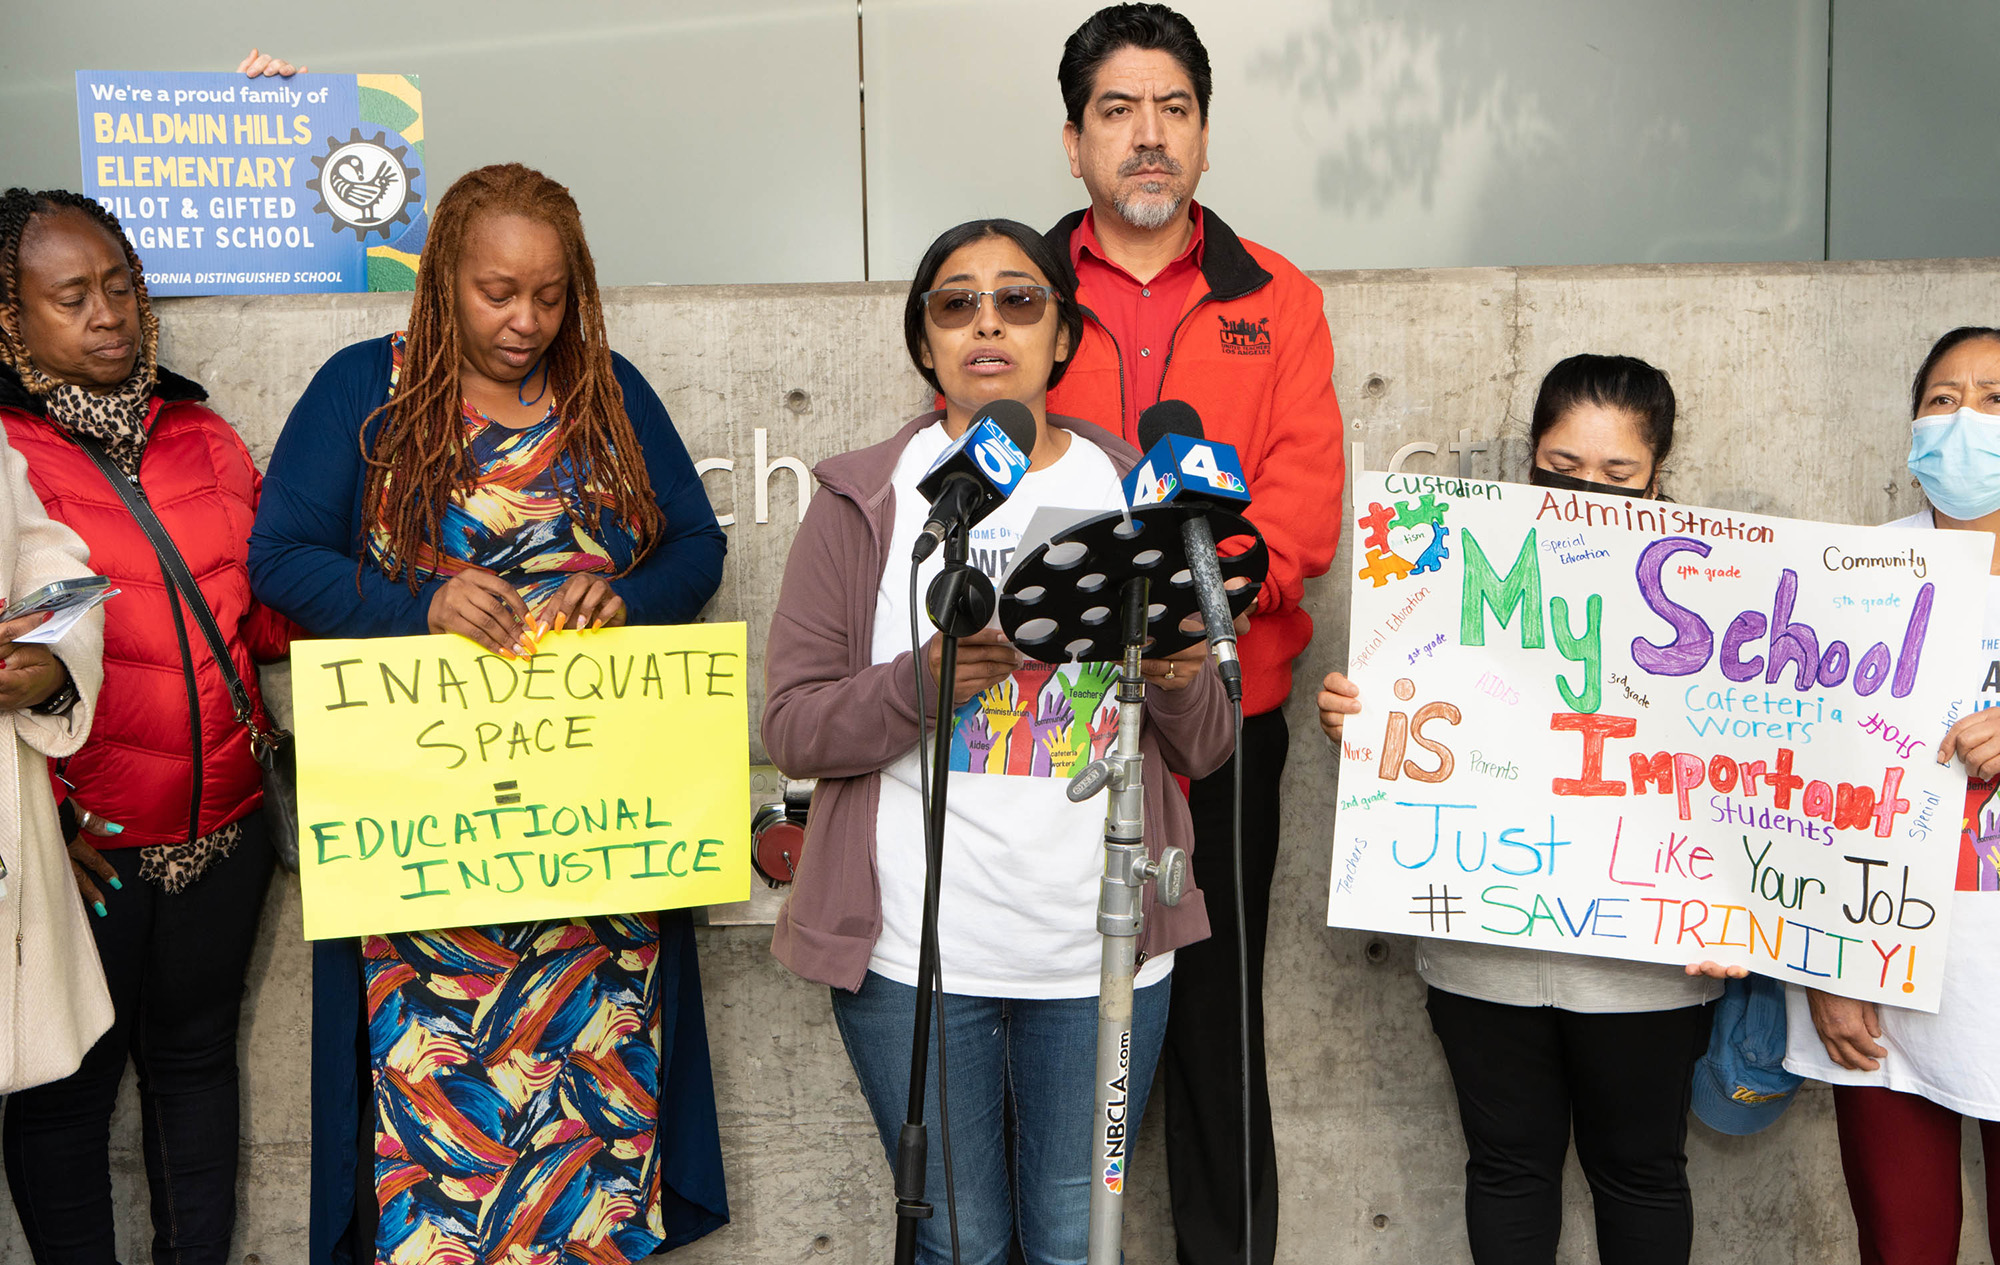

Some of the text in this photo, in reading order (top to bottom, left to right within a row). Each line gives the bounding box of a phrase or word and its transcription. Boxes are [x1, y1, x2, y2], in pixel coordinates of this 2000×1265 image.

[90, 84, 328, 108] We're a proud family of
[93, 112, 312, 145] BALDWIN HILLS
[97, 156, 296, 188] ELEMENTARY
[98, 196, 296, 219] PILOT & GIFTED
[125, 226, 315, 249] AGNET SCHOOL
[143, 271, 343, 284] FORNIA DISTINGUISHED SCHOOL
[1221, 330, 1270, 346] UTLA
[986, 418, 1026, 467] KTLA
[1180, 444, 1222, 488] 4
[1132, 459, 1161, 506] 4
[1385, 474, 1502, 500] Custodian
[1536, 491, 1774, 544] Administration
[1541, 534, 1586, 552] Special
[1560, 548, 1610, 565] Education
[1677, 566, 1742, 582] 4th grade
[1823, 546, 1927, 578] Community
[1833, 594, 1901, 612] 5th grade
[1350, 587, 1431, 670] Special Education
[1460, 527, 1935, 714] My School
[1408, 633, 1447, 666] 1st grade
[321, 650, 738, 712] INADEQUATE
[1069, 688, 1104, 701] Teachers
[1474, 671, 1520, 706] AIDES
[1607, 673, 1627, 687] 3rd
[1624, 685, 1651, 709] grade
[1684, 685, 1843, 724] Cafeteria
[416, 715, 596, 769] SPACE
[969, 741, 990, 751] Aides
[1686, 716, 1815, 744] Worers
[1051, 750, 1078, 758] cafeteria
[1343, 740, 1374, 762] Nurse
[1469, 750, 1519, 781] Parents
[1550, 712, 1911, 838] Important
[1341, 790, 1388, 811] 2nd grade
[1908, 790, 1942, 843] Special
[309, 796, 673, 865] EDUCATIONAL
[1710, 795, 1835, 846] Students
[400, 839, 724, 900] INJUSTICE
[1336, 837, 1368, 895] Teachers
[1392, 801, 1572, 877] Just
[1742, 835, 1826, 911] Your
[1842, 855, 1936, 930] Job
[1106, 1031, 1129, 1158] NBCLA.com
